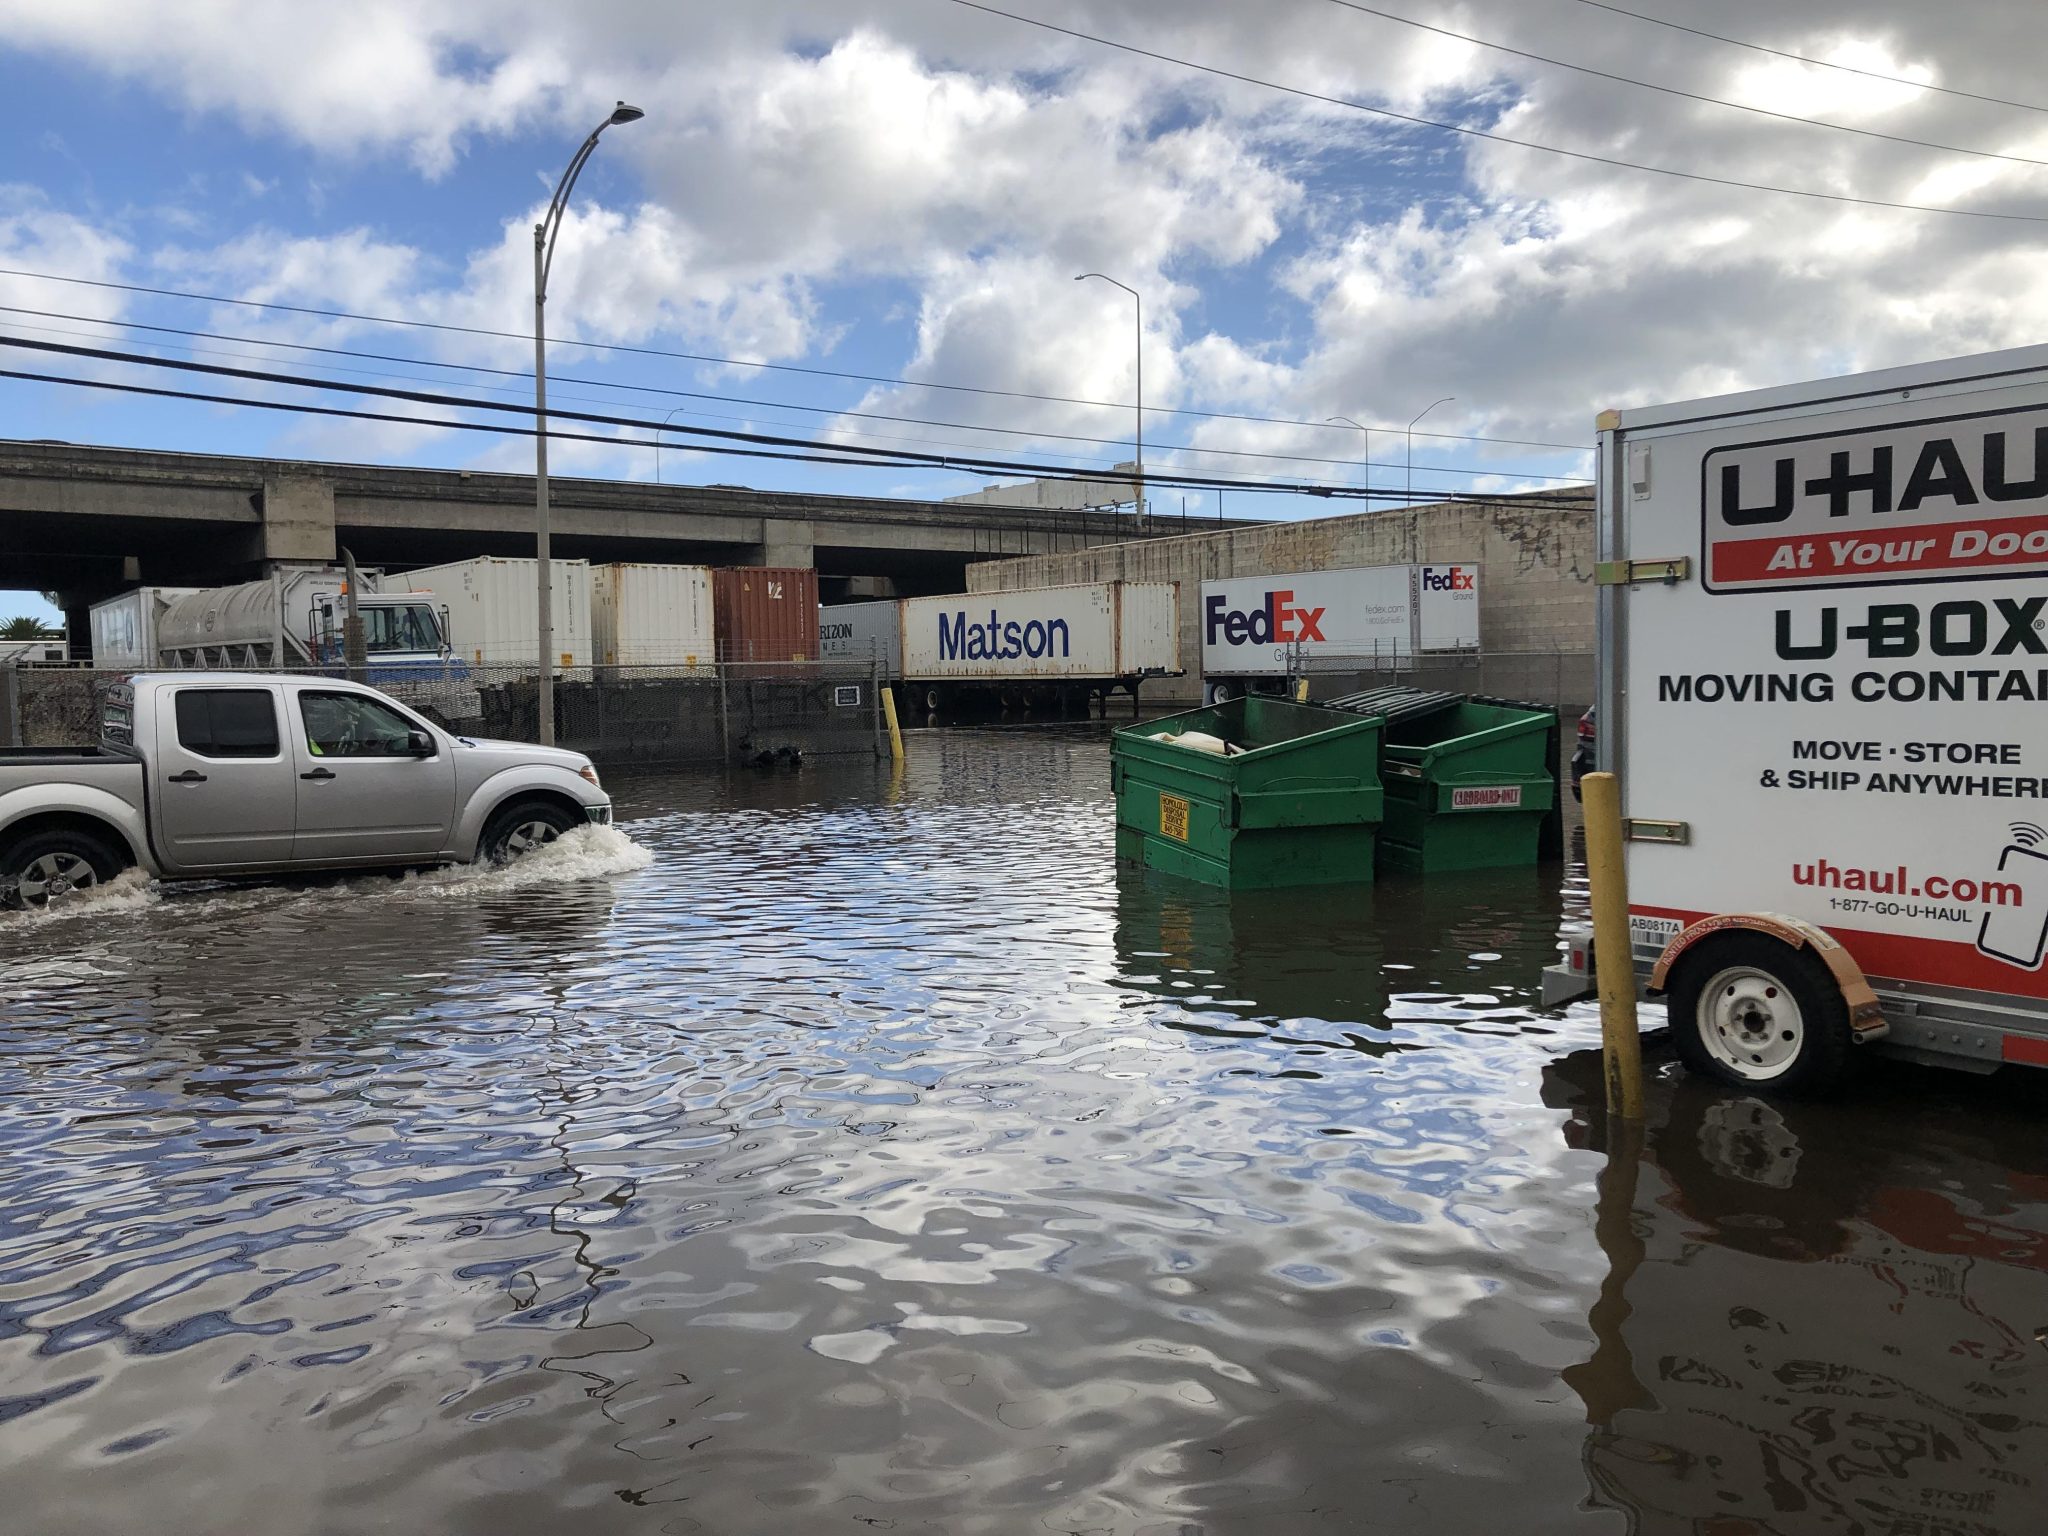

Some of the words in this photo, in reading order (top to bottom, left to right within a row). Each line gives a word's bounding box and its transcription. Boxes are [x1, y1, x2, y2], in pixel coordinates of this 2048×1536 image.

[1722, 426, 2048, 526] U-HAU
[1766, 543, 1815, 571] At
[1830, 537, 1936, 565] Your
[1949, 529, 2048, 558] Doo
[1423, 566, 1474, 591] FedEx
[1365, 604, 1405, 615] fedex.com
[1453, 592, 1474, 601] Ground
[1206, 590, 1326, 646] FedEx
[938, 609, 1069, 661] Matson
[1659, 672, 1834, 702] MOVING
[1792, 741, 1881, 761] MOVE
[1904, 742, 2021, 765] STORE
[1760, 770, 1780, 789] &
[1788, 770, 1860, 791] SHIP
[1792, 859, 2023, 907] uhaul.com
[1830, 898, 1973, 923] 1-877-GO-U-HAUL
